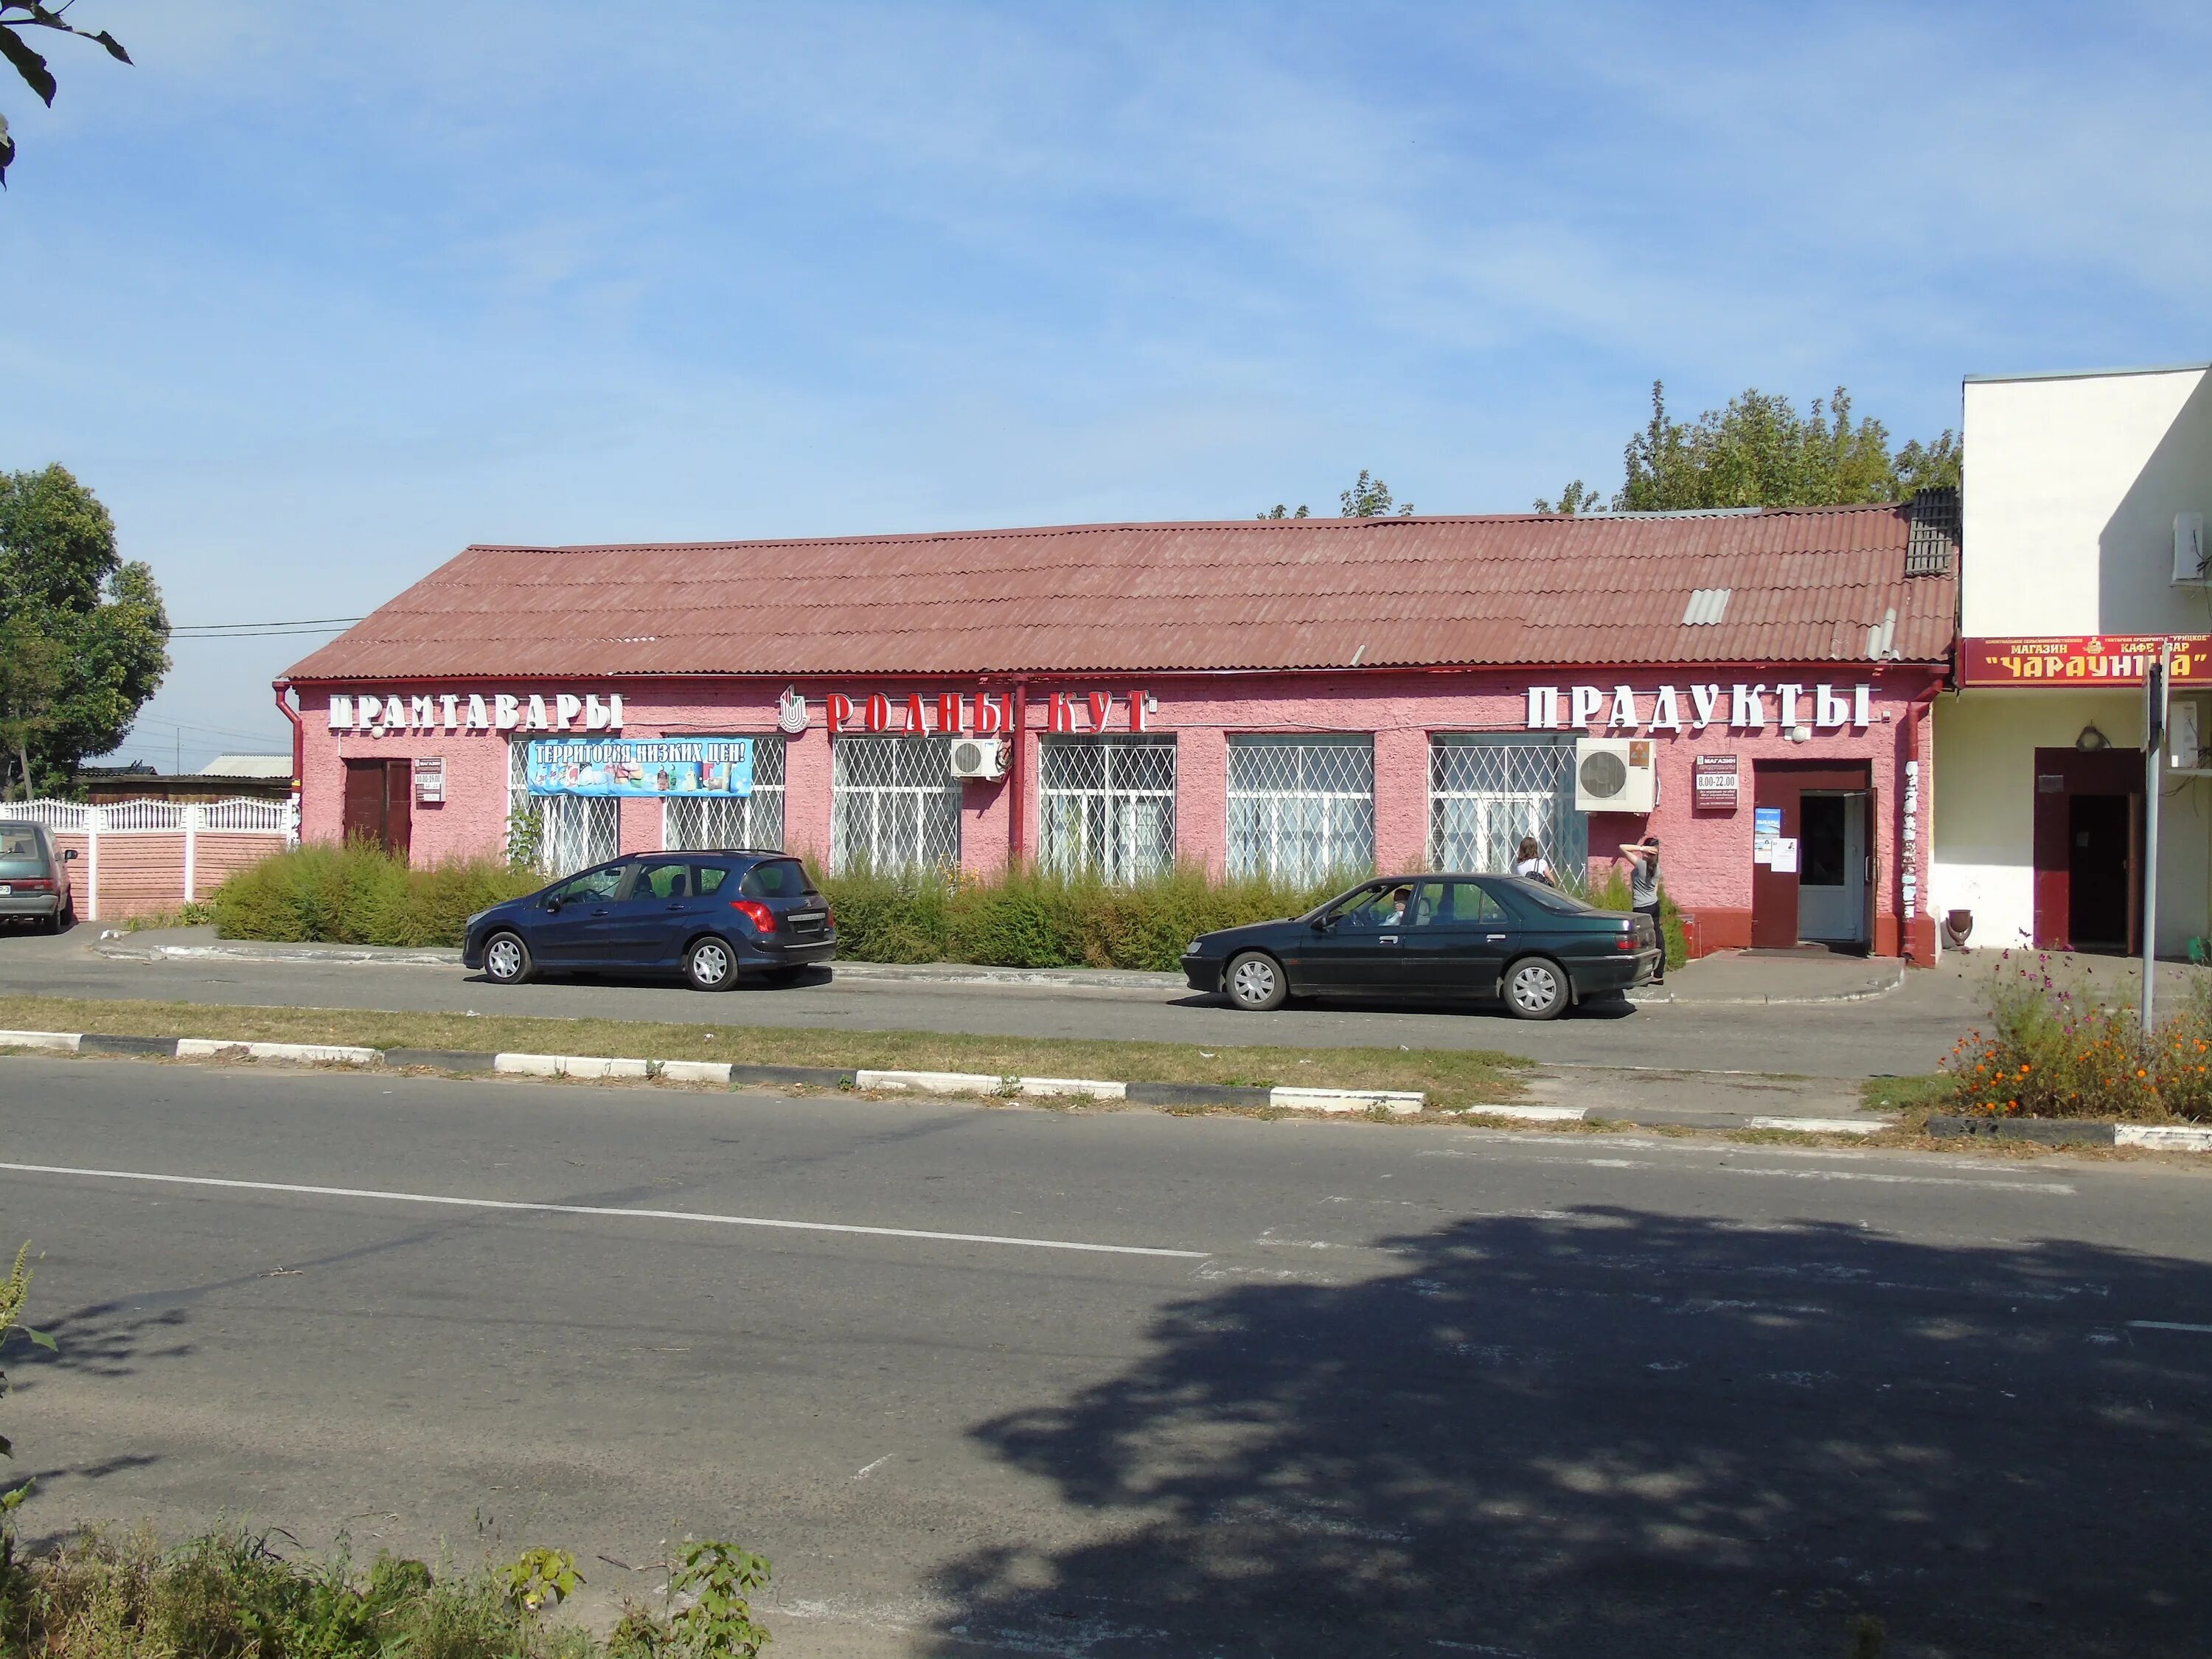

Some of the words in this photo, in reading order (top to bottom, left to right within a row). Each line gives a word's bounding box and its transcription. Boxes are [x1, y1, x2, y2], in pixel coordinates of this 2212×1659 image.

[2011, 644, 2067, 654] МАГАЗИН
[2121, 642, 2154, 653] КАФЕ
[328, 694, 625, 729] ПРАМТАВАРЫ
[827, 692, 1015, 737] РОДНЫ
[1048, 690, 1150, 734] КУТ
[1527, 684, 1871, 733] ПРАДУКТЫ
[535, 744, 632, 764] ТЕРРИТОРИЯ
[636, 743, 703, 763] НИЗКИХ
[708, 742, 745, 765] ЦЕН!
[1699, 776, 1735, 787] 8.00-22.00
